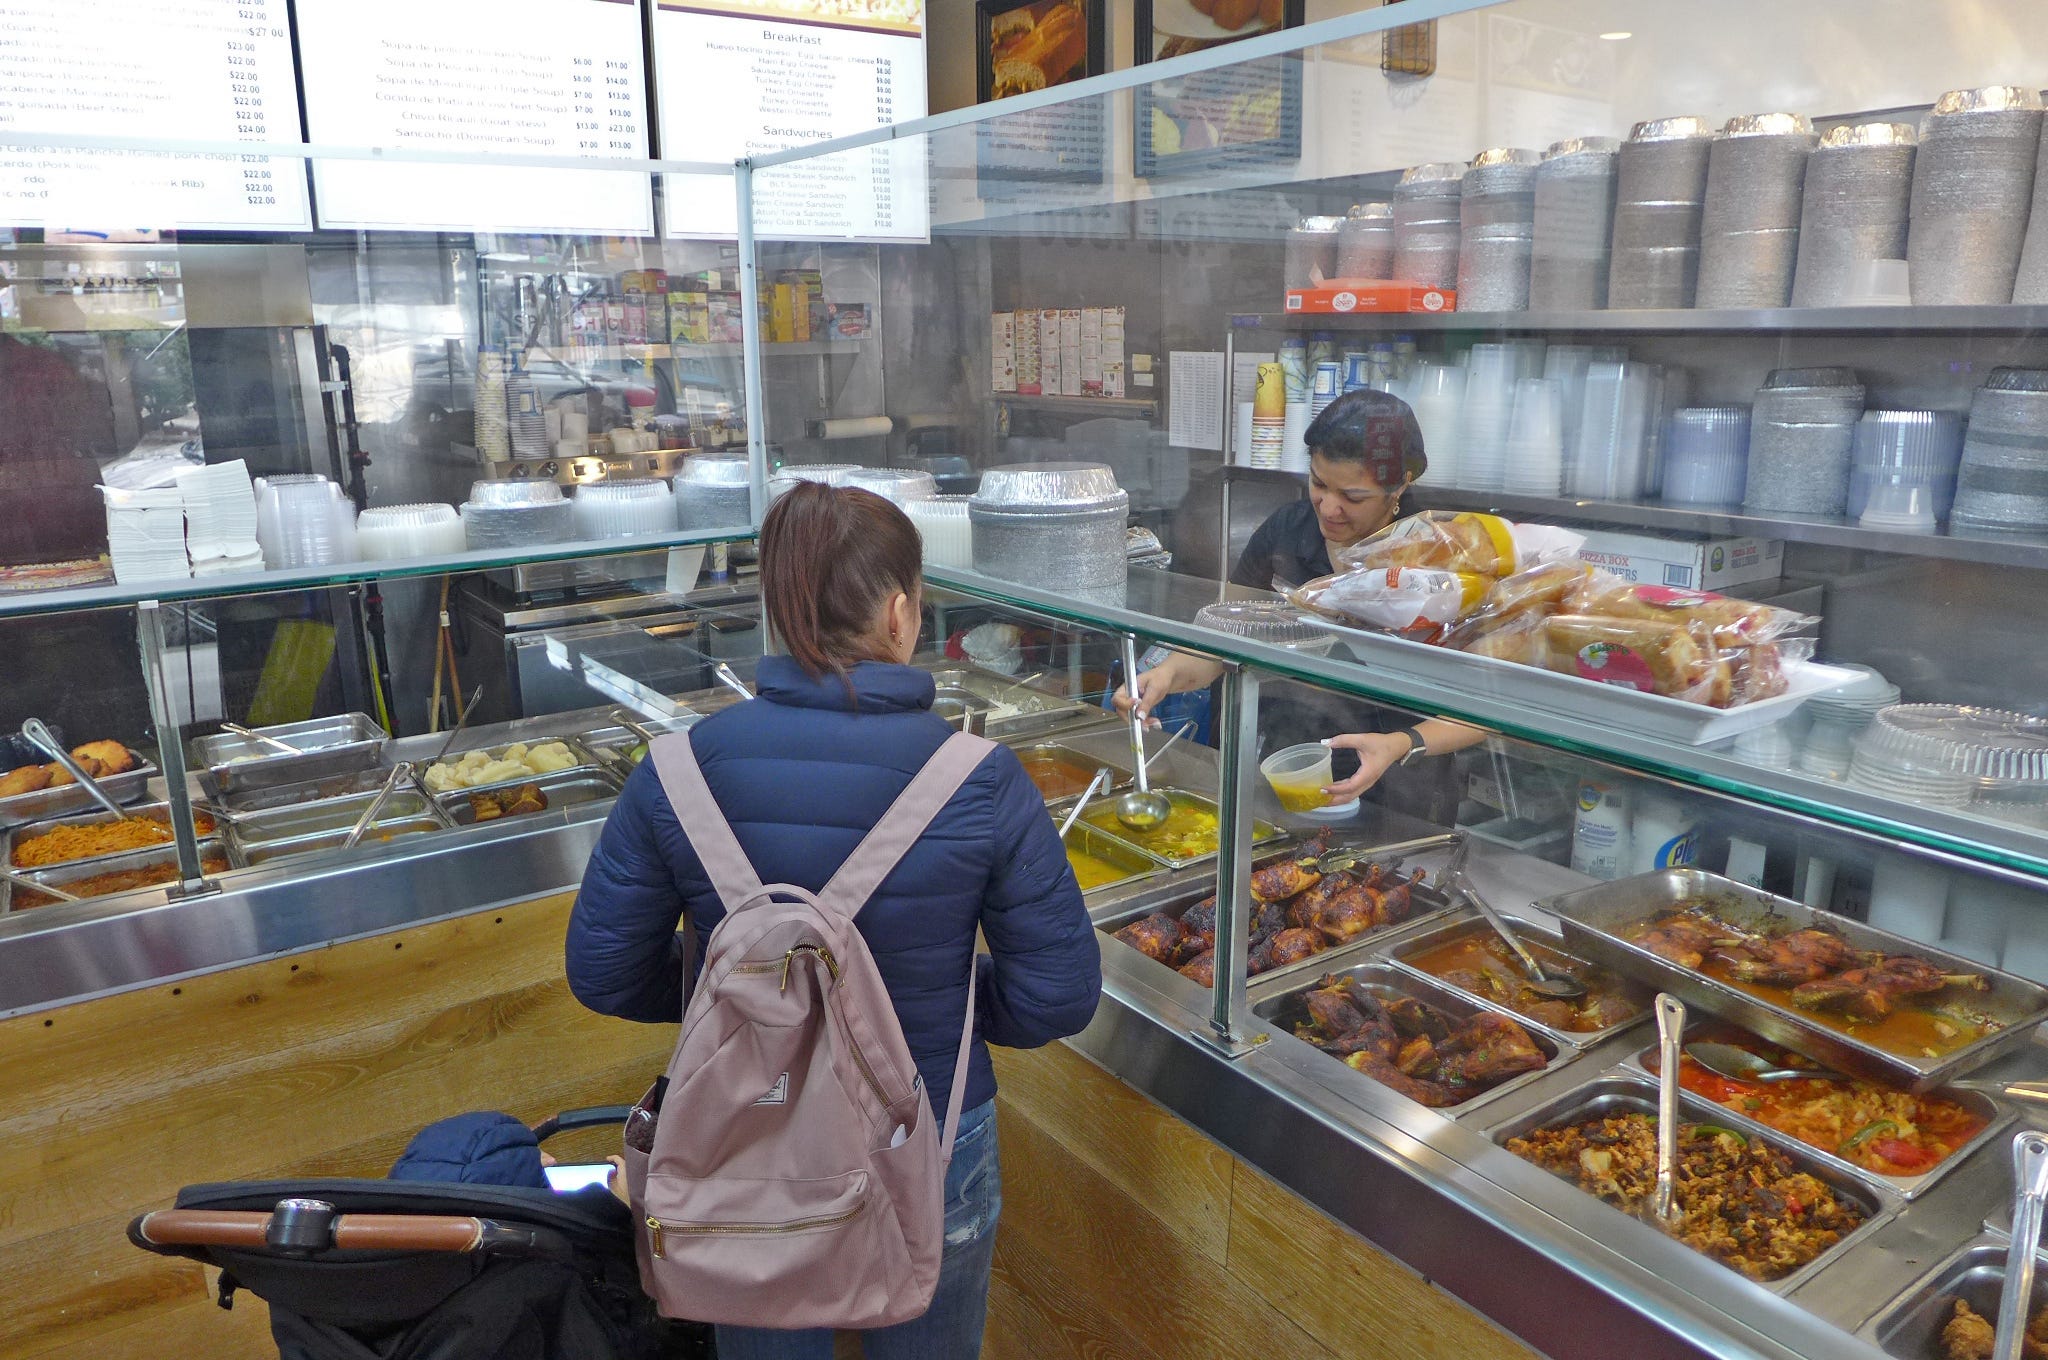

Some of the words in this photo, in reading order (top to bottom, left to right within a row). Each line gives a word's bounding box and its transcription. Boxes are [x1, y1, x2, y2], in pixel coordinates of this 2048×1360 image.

[763, 30, 822, 45] Breakfast
[227, 56, 256, 66] $22.00
[606, 61, 628, 70] $11.00
[229, 71, 258, 81] $22.00
[606, 77, 628, 85] $14.00
[232, 84, 260, 94] $22.00
[234, 97, 262, 107] $22.00
[236, 111, 264, 121] $22.00
[609, 108, 632, 118] $13.00
[238, 125, 266, 134] $24.00
[763, 125, 833, 139] Sandwiches
[580, 140, 599, 149] $7.00
[609, 140, 632, 150] $13.00
[241, 154, 269, 164] $22.00
[243, 170, 271, 179] $22.00
[181, 179, 206, 190] Rib)
[245, 184, 273, 193] $22.00
[248, 196, 276, 206] $22.00
[808, 192, 848, 201] Sandwich
[805, 201, 844, 209] Sandwich
[1579, 551, 1606, 564] PIZZA
[1608, 555, 1630, 567] BOX
